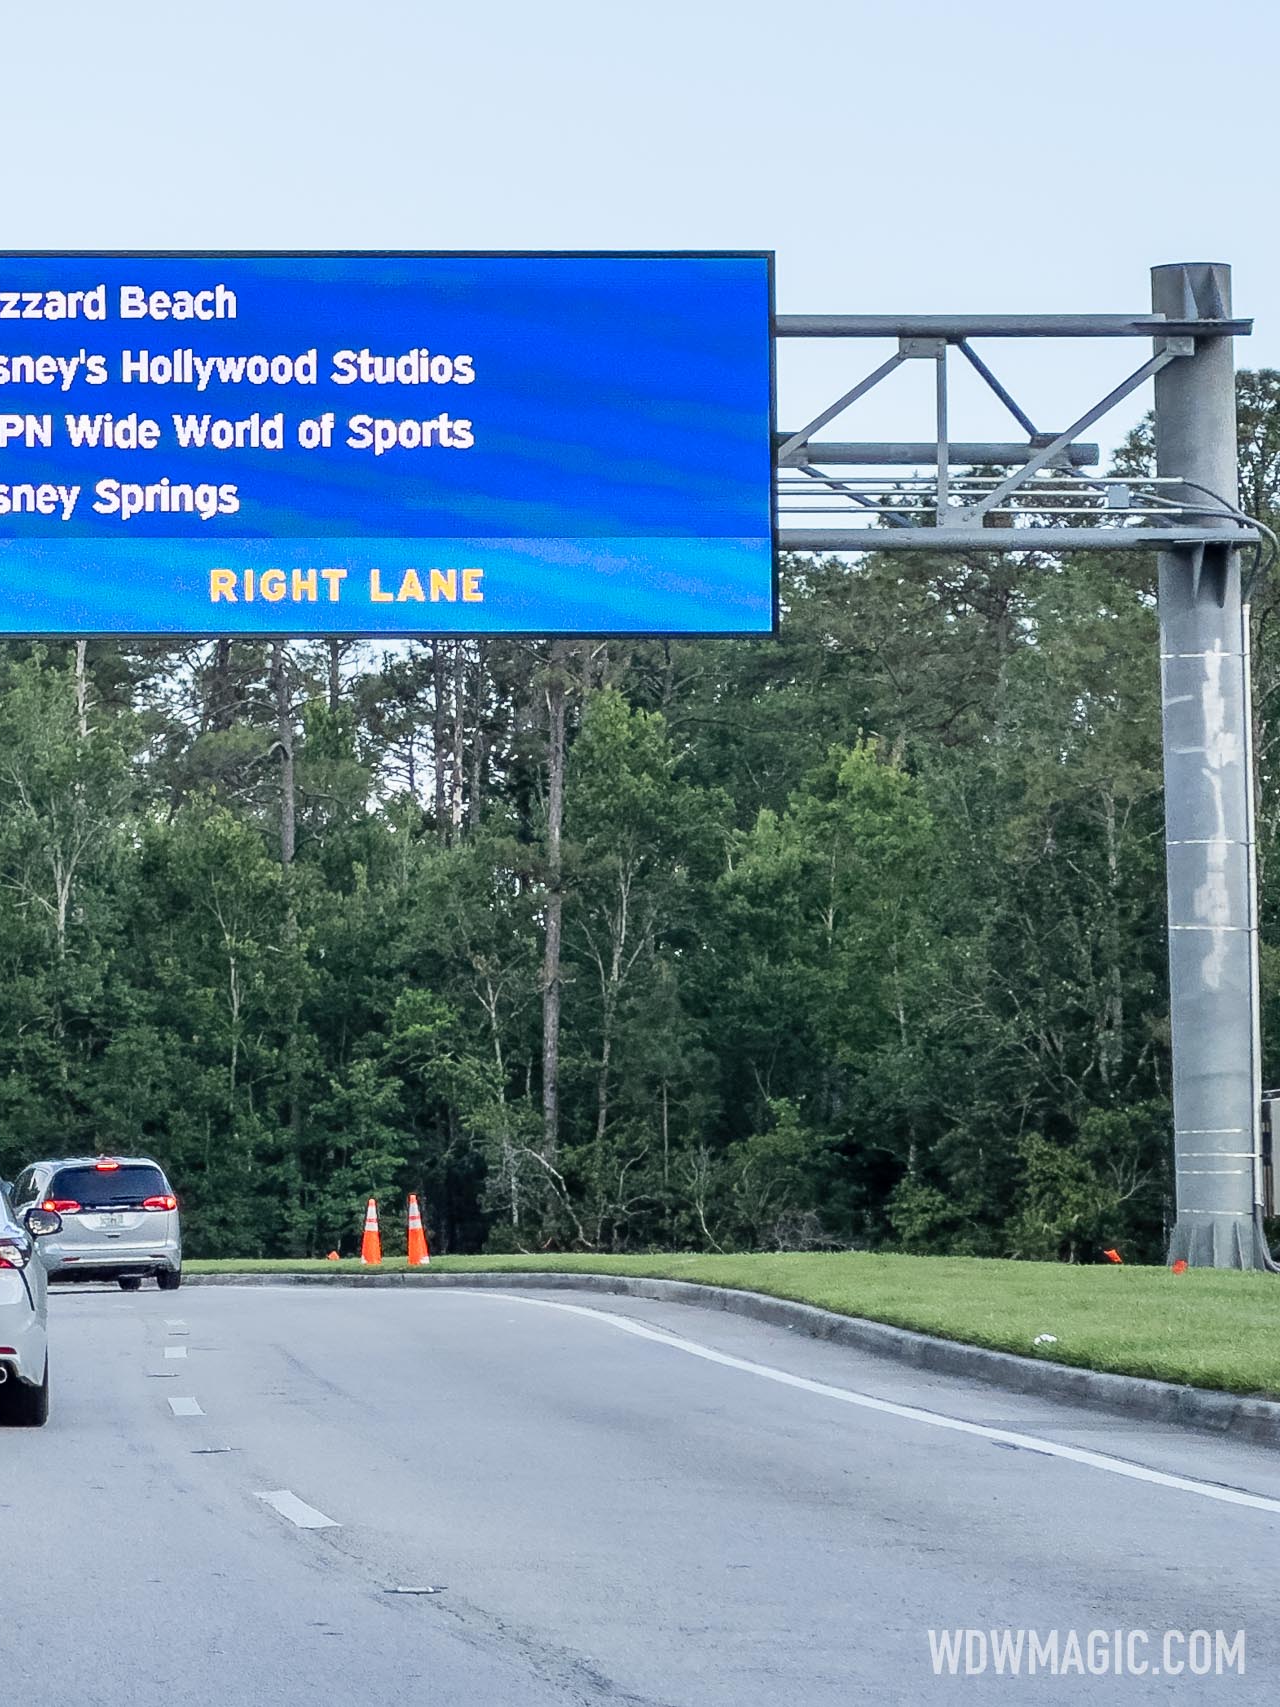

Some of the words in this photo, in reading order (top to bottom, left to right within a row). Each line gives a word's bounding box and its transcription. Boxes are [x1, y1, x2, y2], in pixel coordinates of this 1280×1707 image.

[121, 284, 236, 320] Beach
[123, 349, 317, 391] Hollywood
[331, 349, 475, 384] Studios
[65, 413, 160, 448] Wide
[172, 413, 283, 449] World
[299, 413, 334, 448] of
[346, 413, 474, 455] Sports
[93, 478, 239, 520] Springs
[209, 569, 347, 602] RIGHT
[370, 569, 483, 602] LANE
